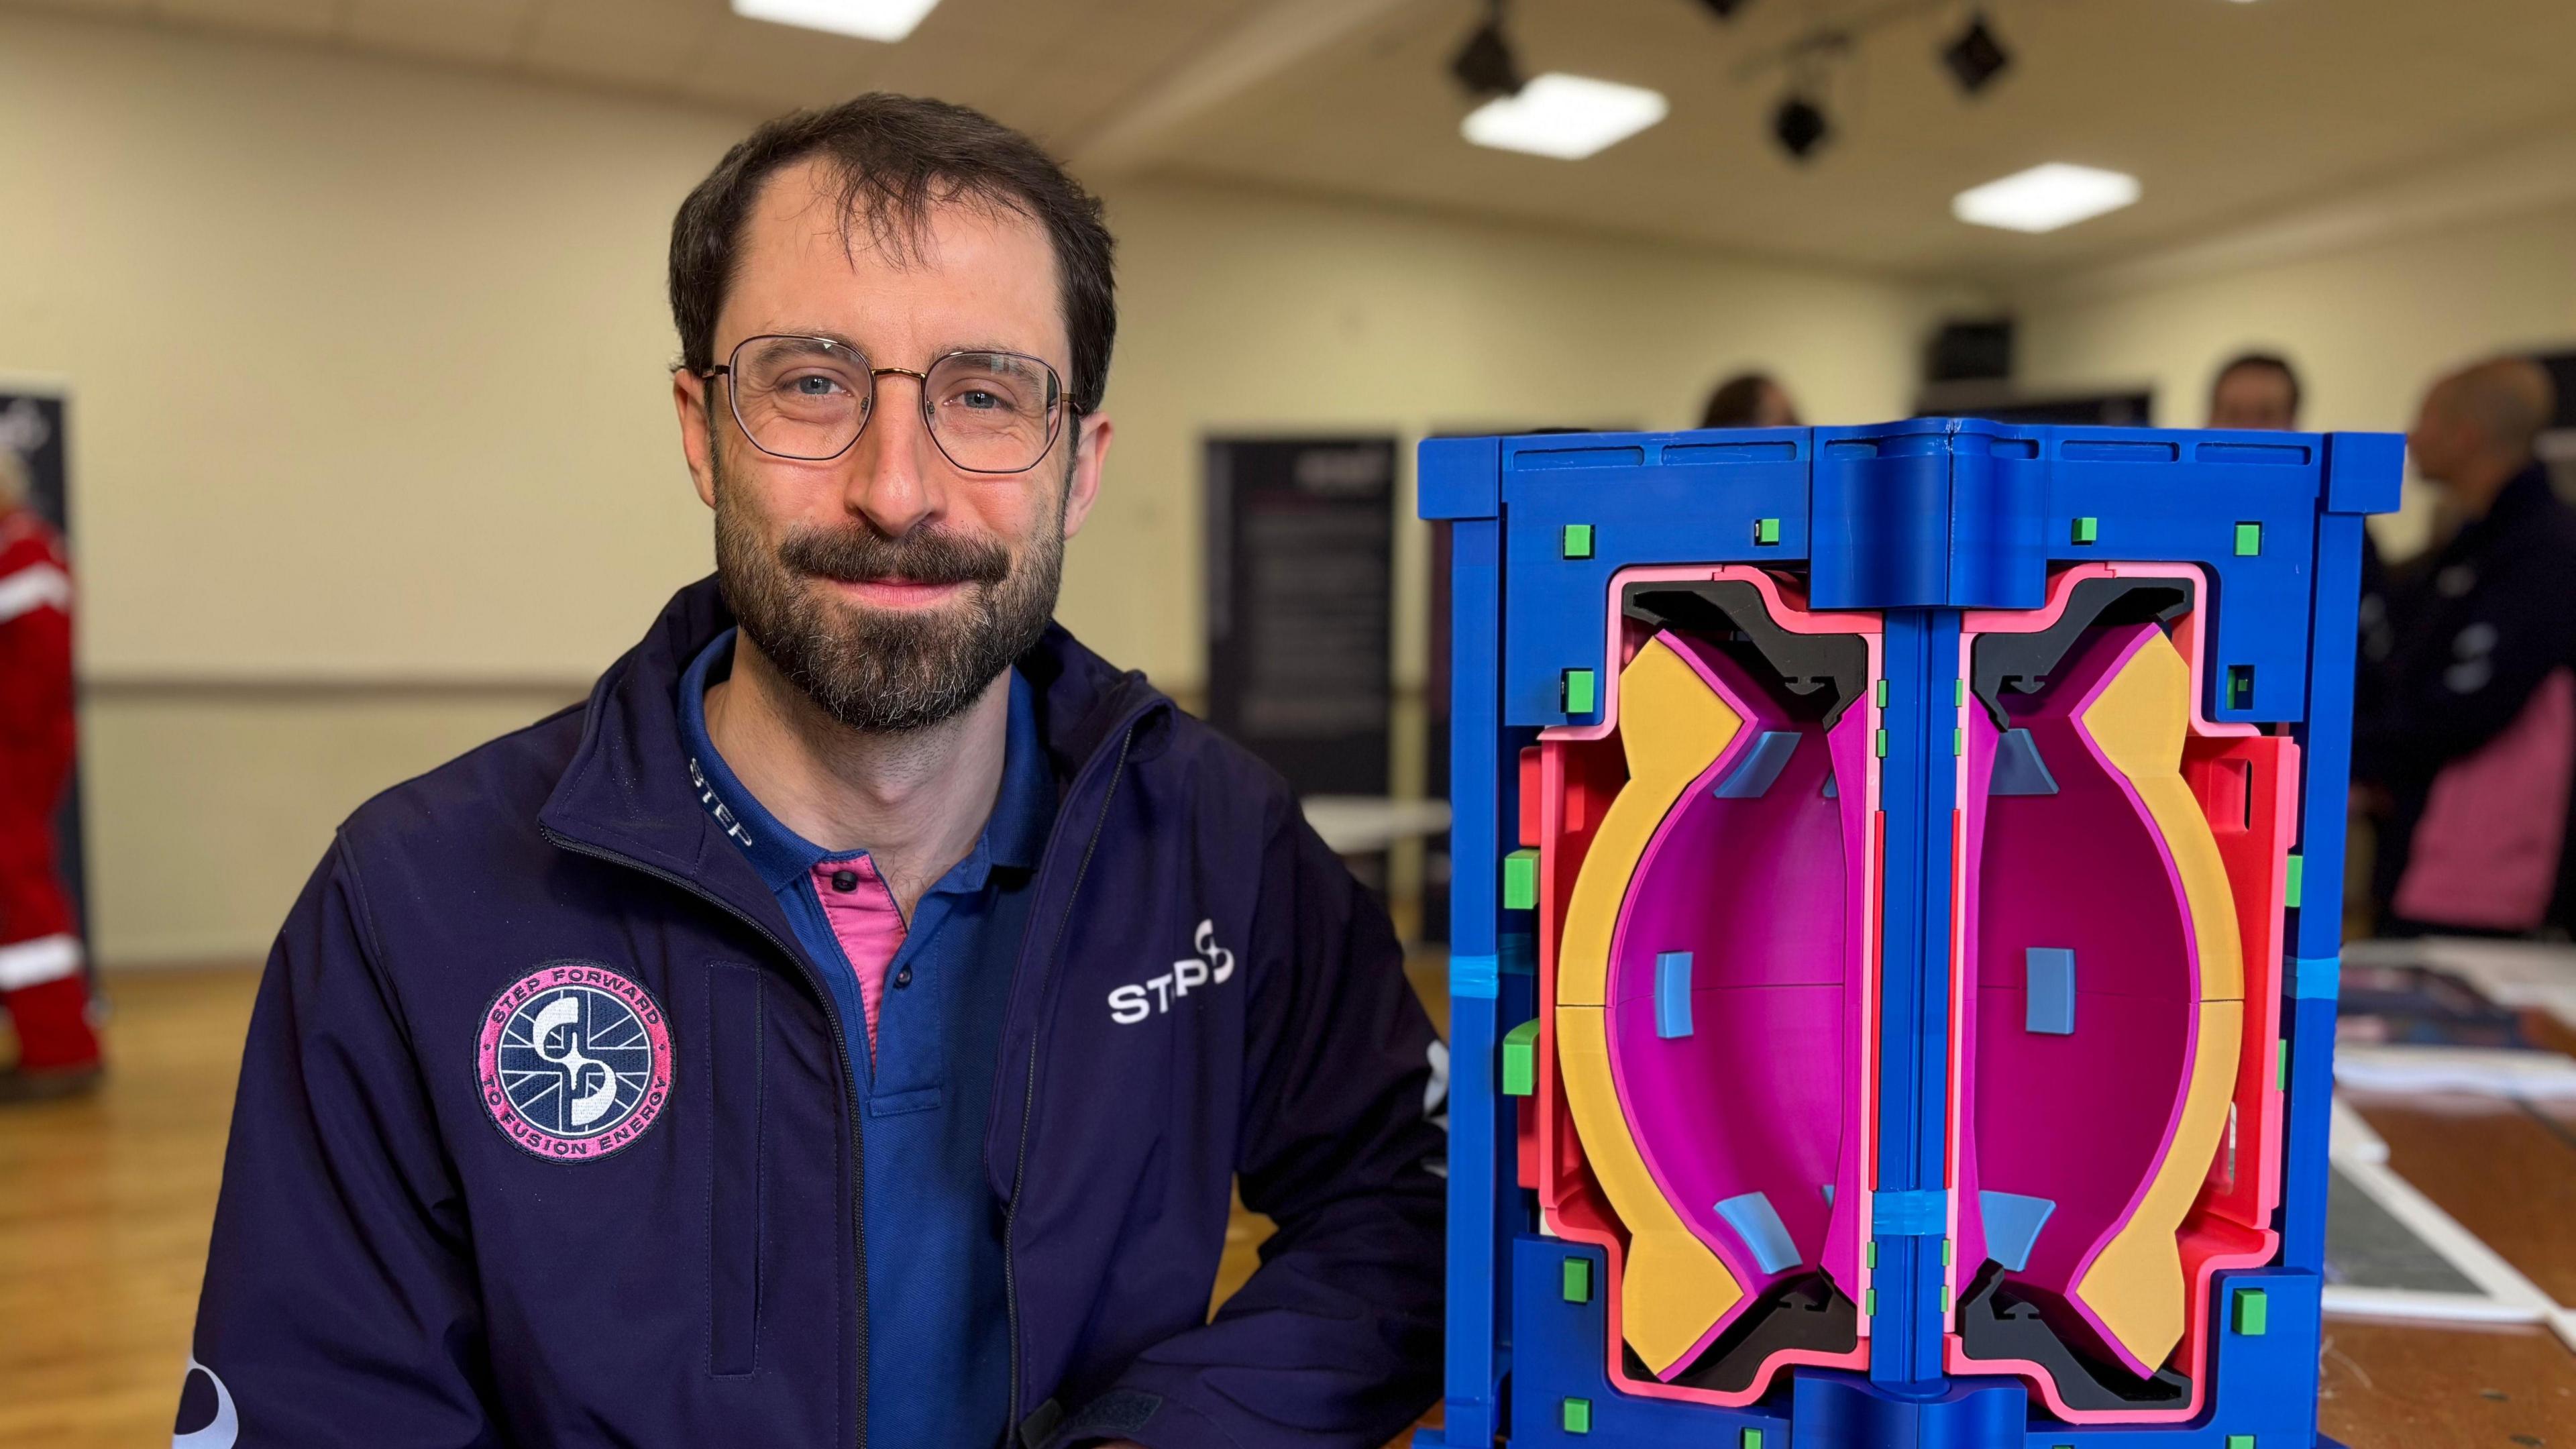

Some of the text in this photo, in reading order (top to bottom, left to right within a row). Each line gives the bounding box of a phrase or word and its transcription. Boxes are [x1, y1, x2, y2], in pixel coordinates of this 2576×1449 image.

[690, 757, 752, 847] STEP
[491, 969, 660, 1026] STEP FORWARD
[1107, 958, 1209, 1025] STP
[482, 1075, 668, 1155] TO FUSION ENERGY
